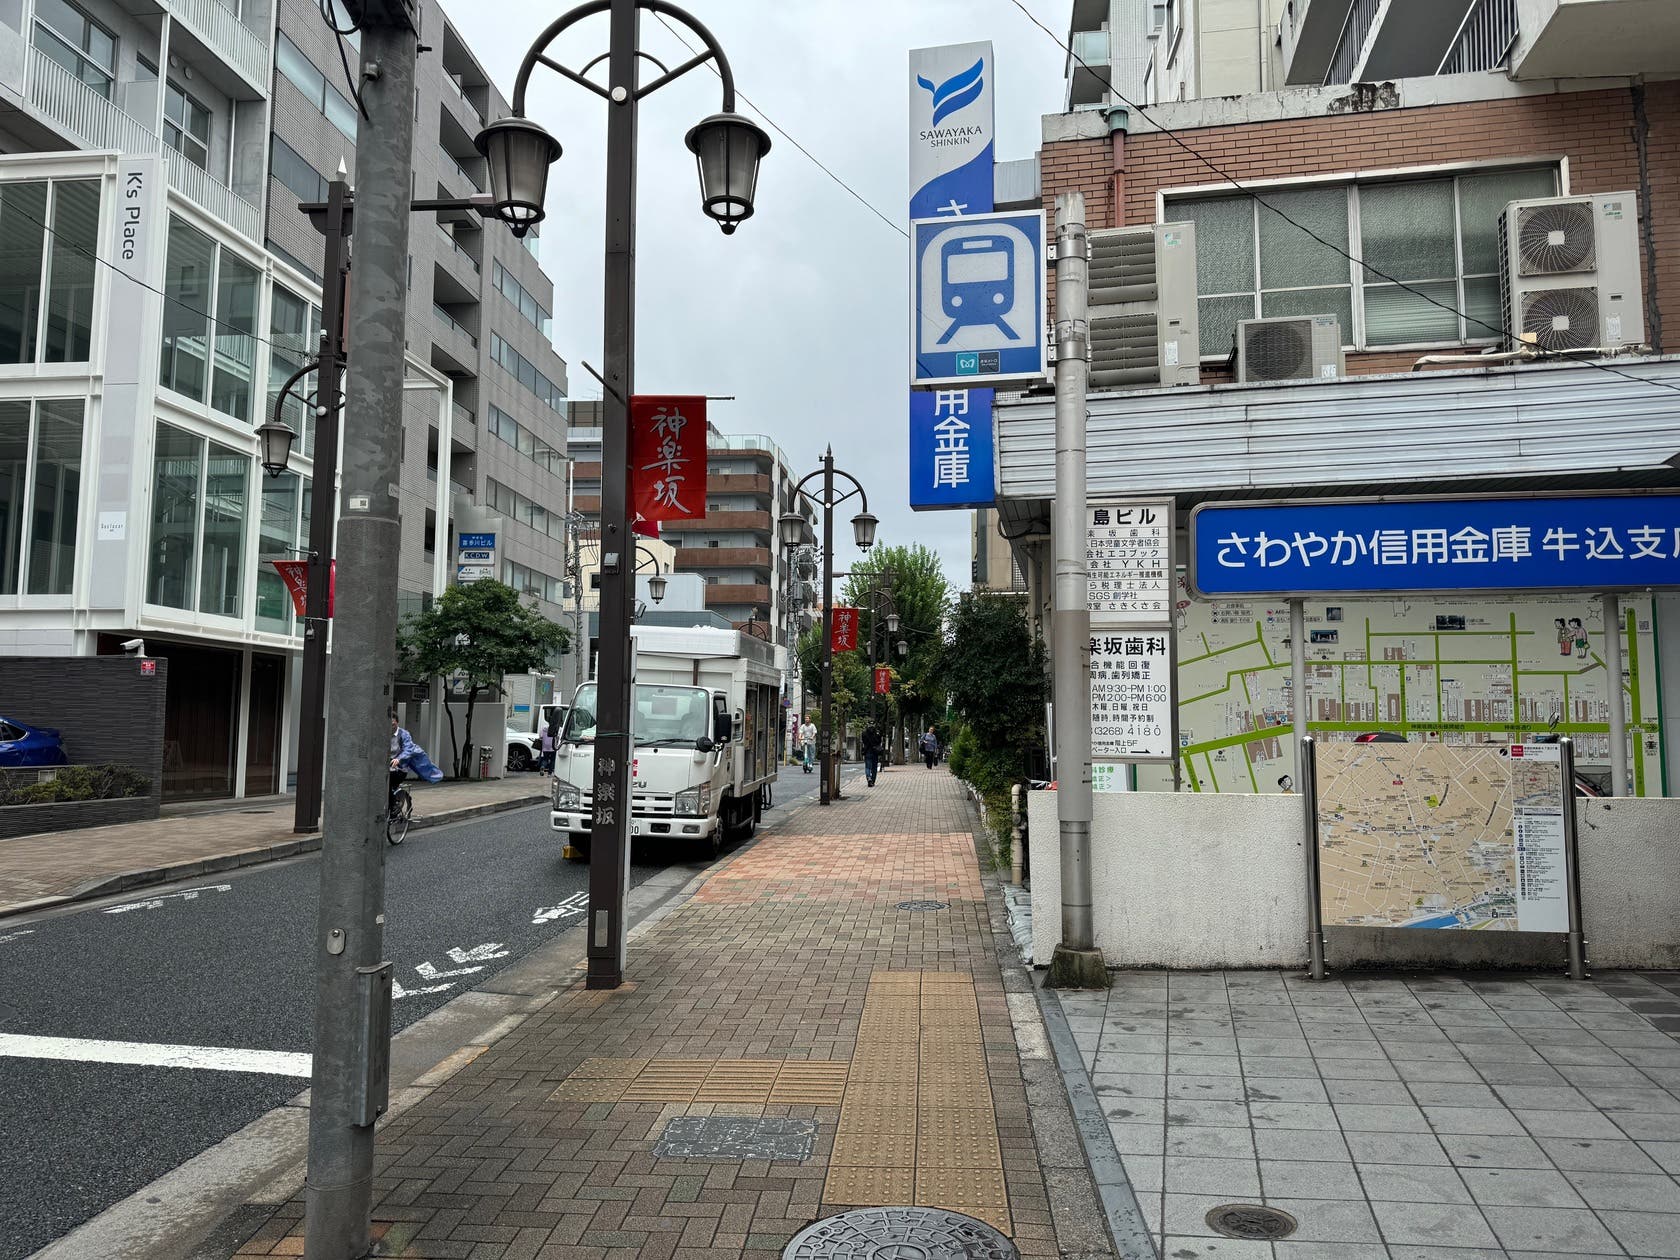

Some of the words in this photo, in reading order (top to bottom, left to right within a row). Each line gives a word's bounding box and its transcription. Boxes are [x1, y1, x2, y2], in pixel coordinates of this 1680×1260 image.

[919, 125, 982, 141] SAWAYAKA
[930, 136, 971, 148] SHINKIN
[126, 171, 143, 199] K's
[122, 206, 141, 260] Place
[933, 388, 971, 489] 用金庫
[641, 407, 693, 514] 神楽坂
[1093, 508, 1156, 526] 島ビル
[1086, 539, 1160, 548] 日本児童文学者協会
[1216, 524, 1533, 568] さわやか信用金庫
[1541, 524, 1680, 562] 牛込支
[1089, 591, 1111, 600] SGS
[1108, 601, 1161, 611] さきくさ会
[834, 611, 852, 649] 神楽坂
[1090, 636, 1166, 656] 楽坂歯科
[1090, 660, 1151, 670] 合機能回復
[1091, 726, 1123, 736] (3268)
[1127, 727, 1161, 737] 4180
